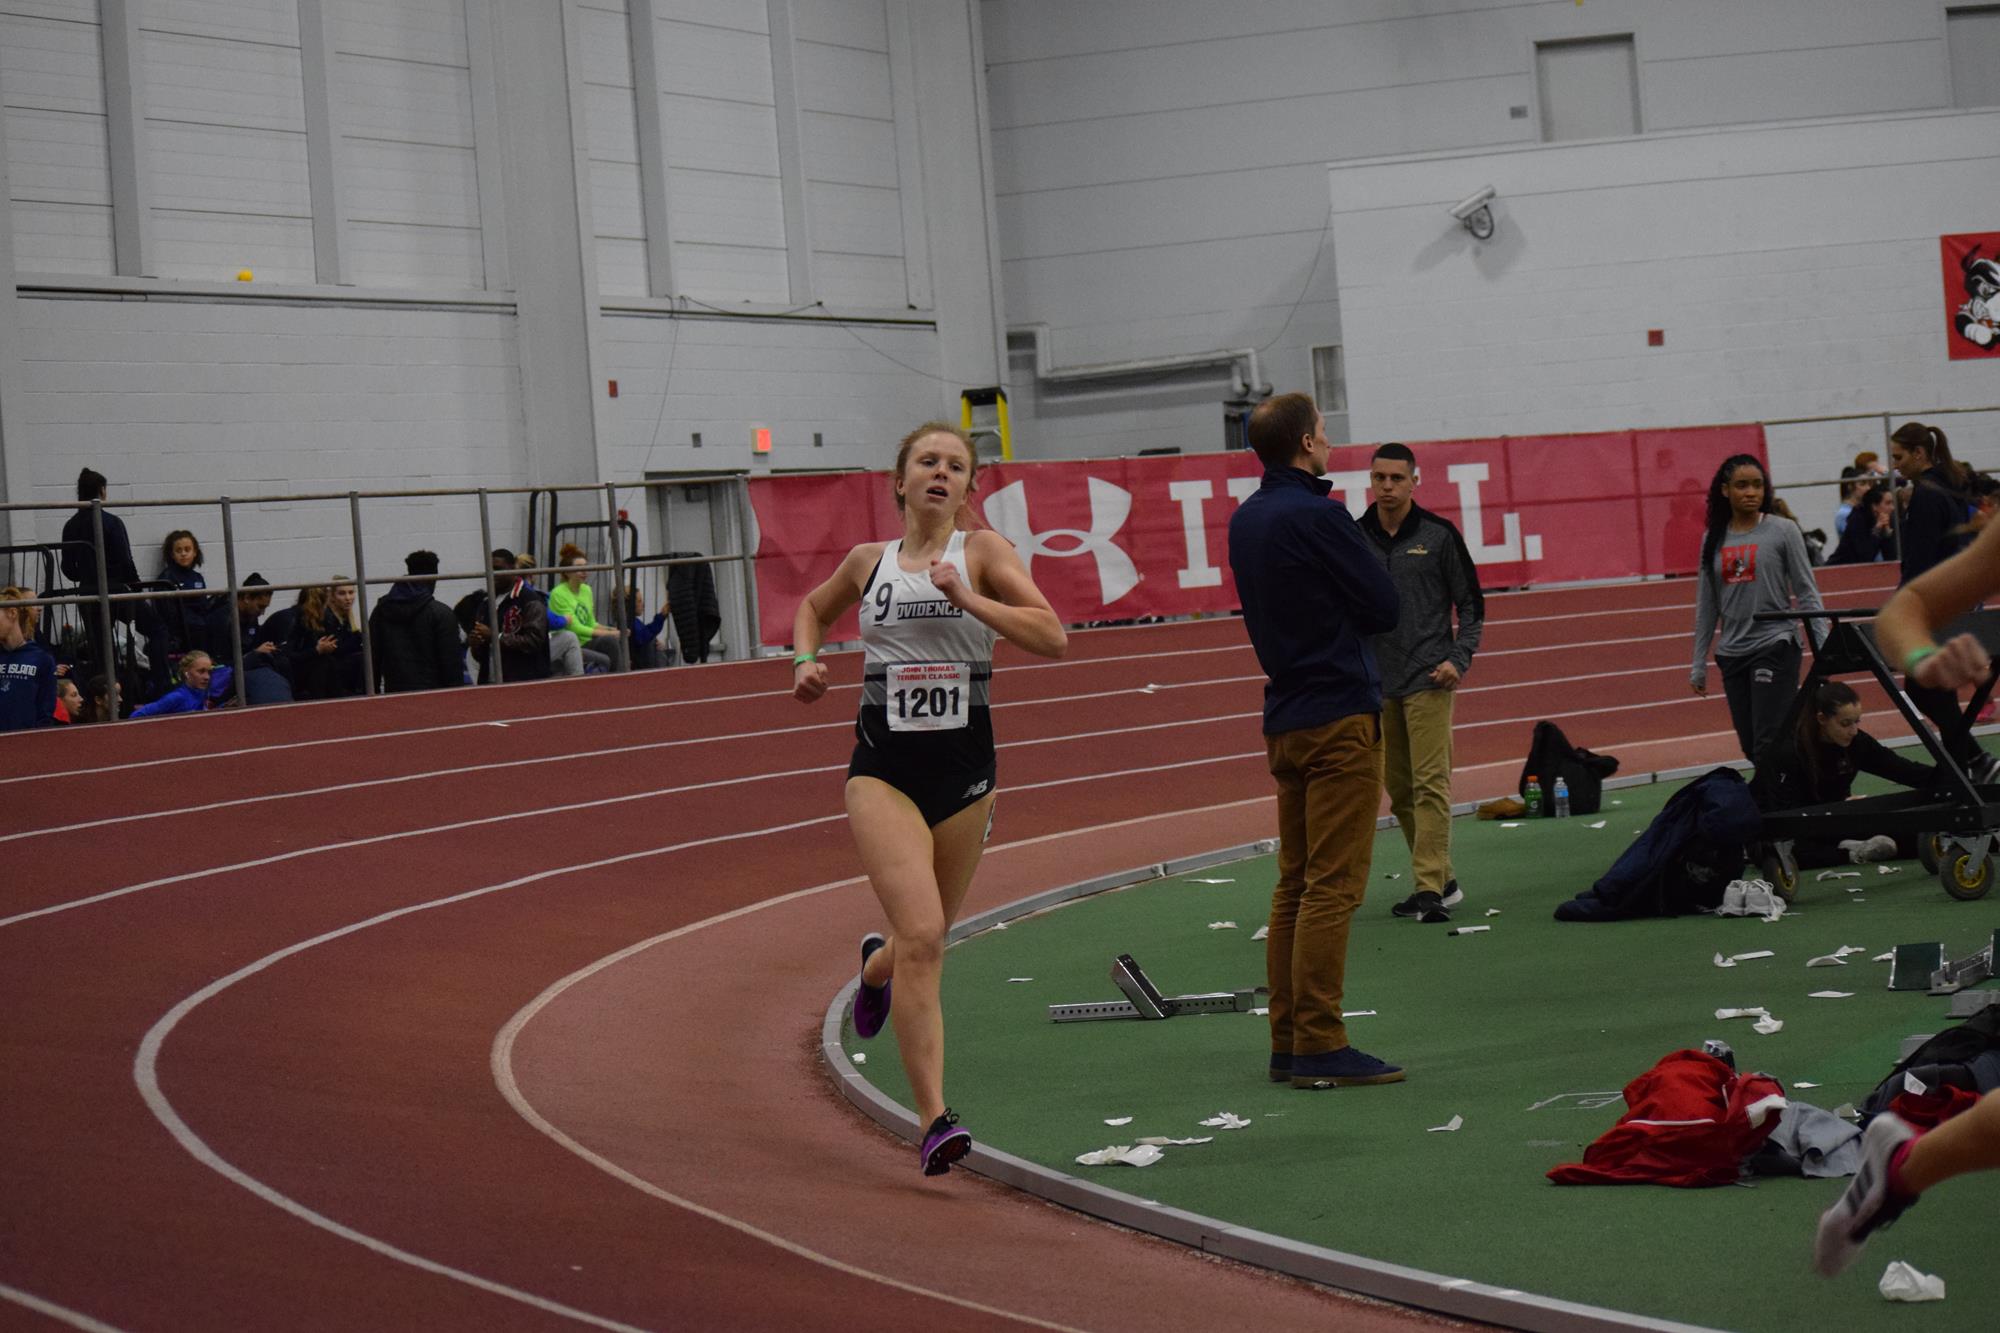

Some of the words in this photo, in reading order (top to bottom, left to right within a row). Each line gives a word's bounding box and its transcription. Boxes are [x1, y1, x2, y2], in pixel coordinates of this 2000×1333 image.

[874, 582, 893, 622] 9
[7, 664, 37, 676] ISLAND
[924, 665, 956, 673] THOMAS
[894, 687, 960, 719] 1201
